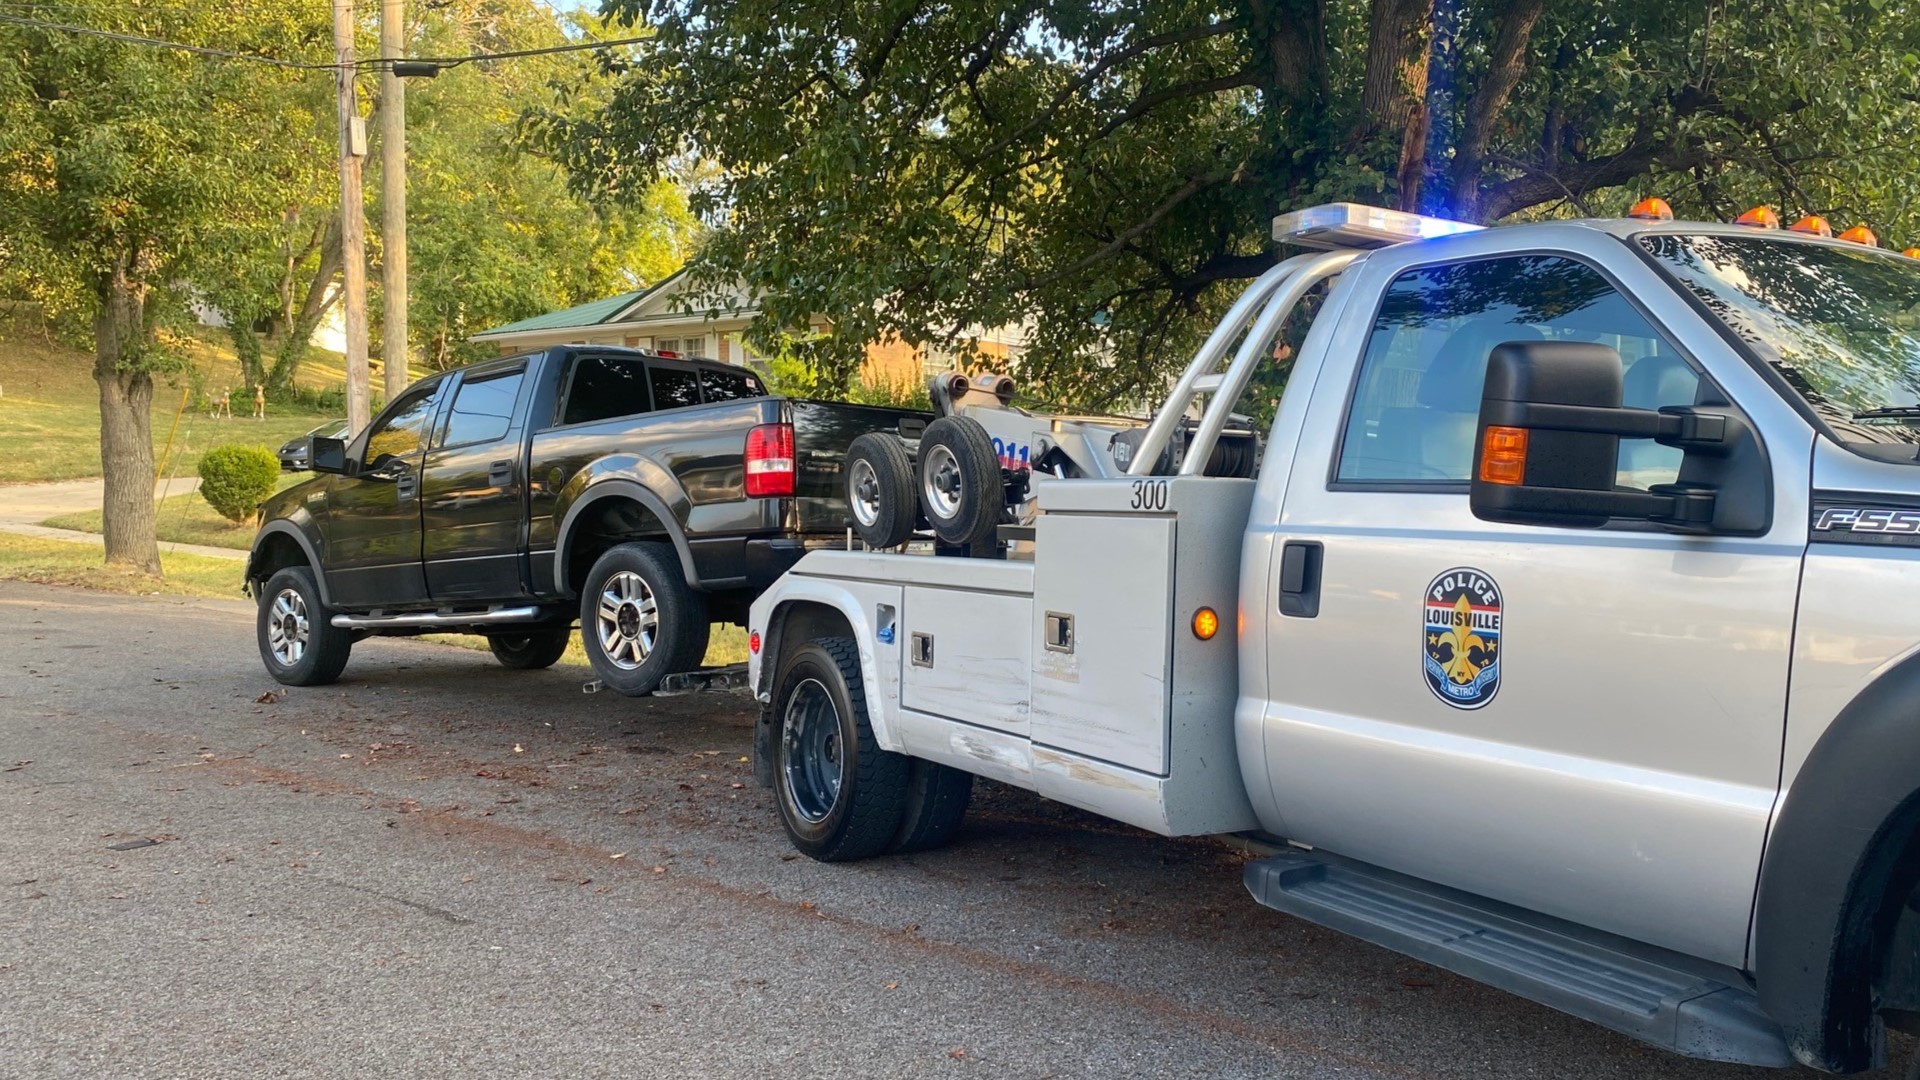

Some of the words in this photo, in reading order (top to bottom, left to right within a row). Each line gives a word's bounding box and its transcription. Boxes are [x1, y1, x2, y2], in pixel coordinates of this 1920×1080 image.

[1131, 479, 1168, 511] 300
[1815, 508, 1920, 534] F-55
[1432, 573, 1496, 605] POLICE
[1426, 608, 1500, 630] LOUISVILLE
[1448, 684, 1474, 697] METRO
